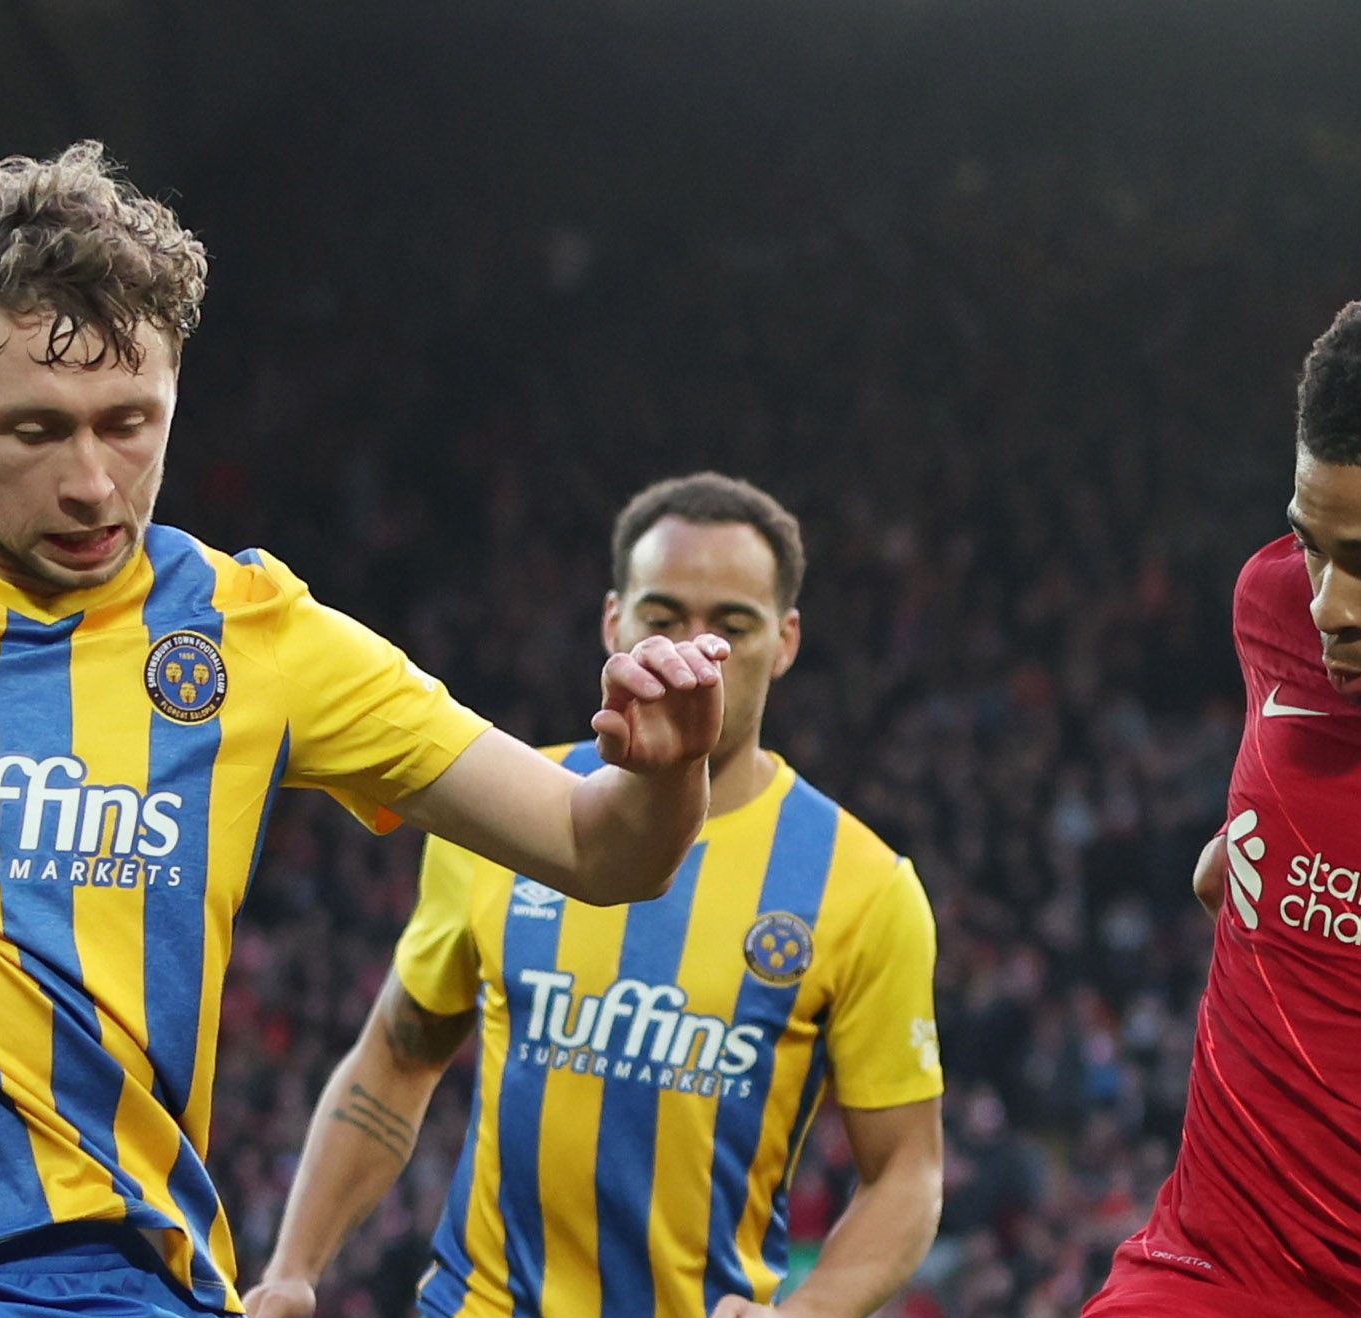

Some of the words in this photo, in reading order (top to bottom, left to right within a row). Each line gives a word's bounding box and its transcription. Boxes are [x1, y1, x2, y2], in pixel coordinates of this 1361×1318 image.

[172, 635, 195, 648] TOWN
[216, 672, 226, 694] CLUB
[520, 968, 764, 1075] Tuffins
[519, 1044, 753, 1099] SUPERMARKETS
